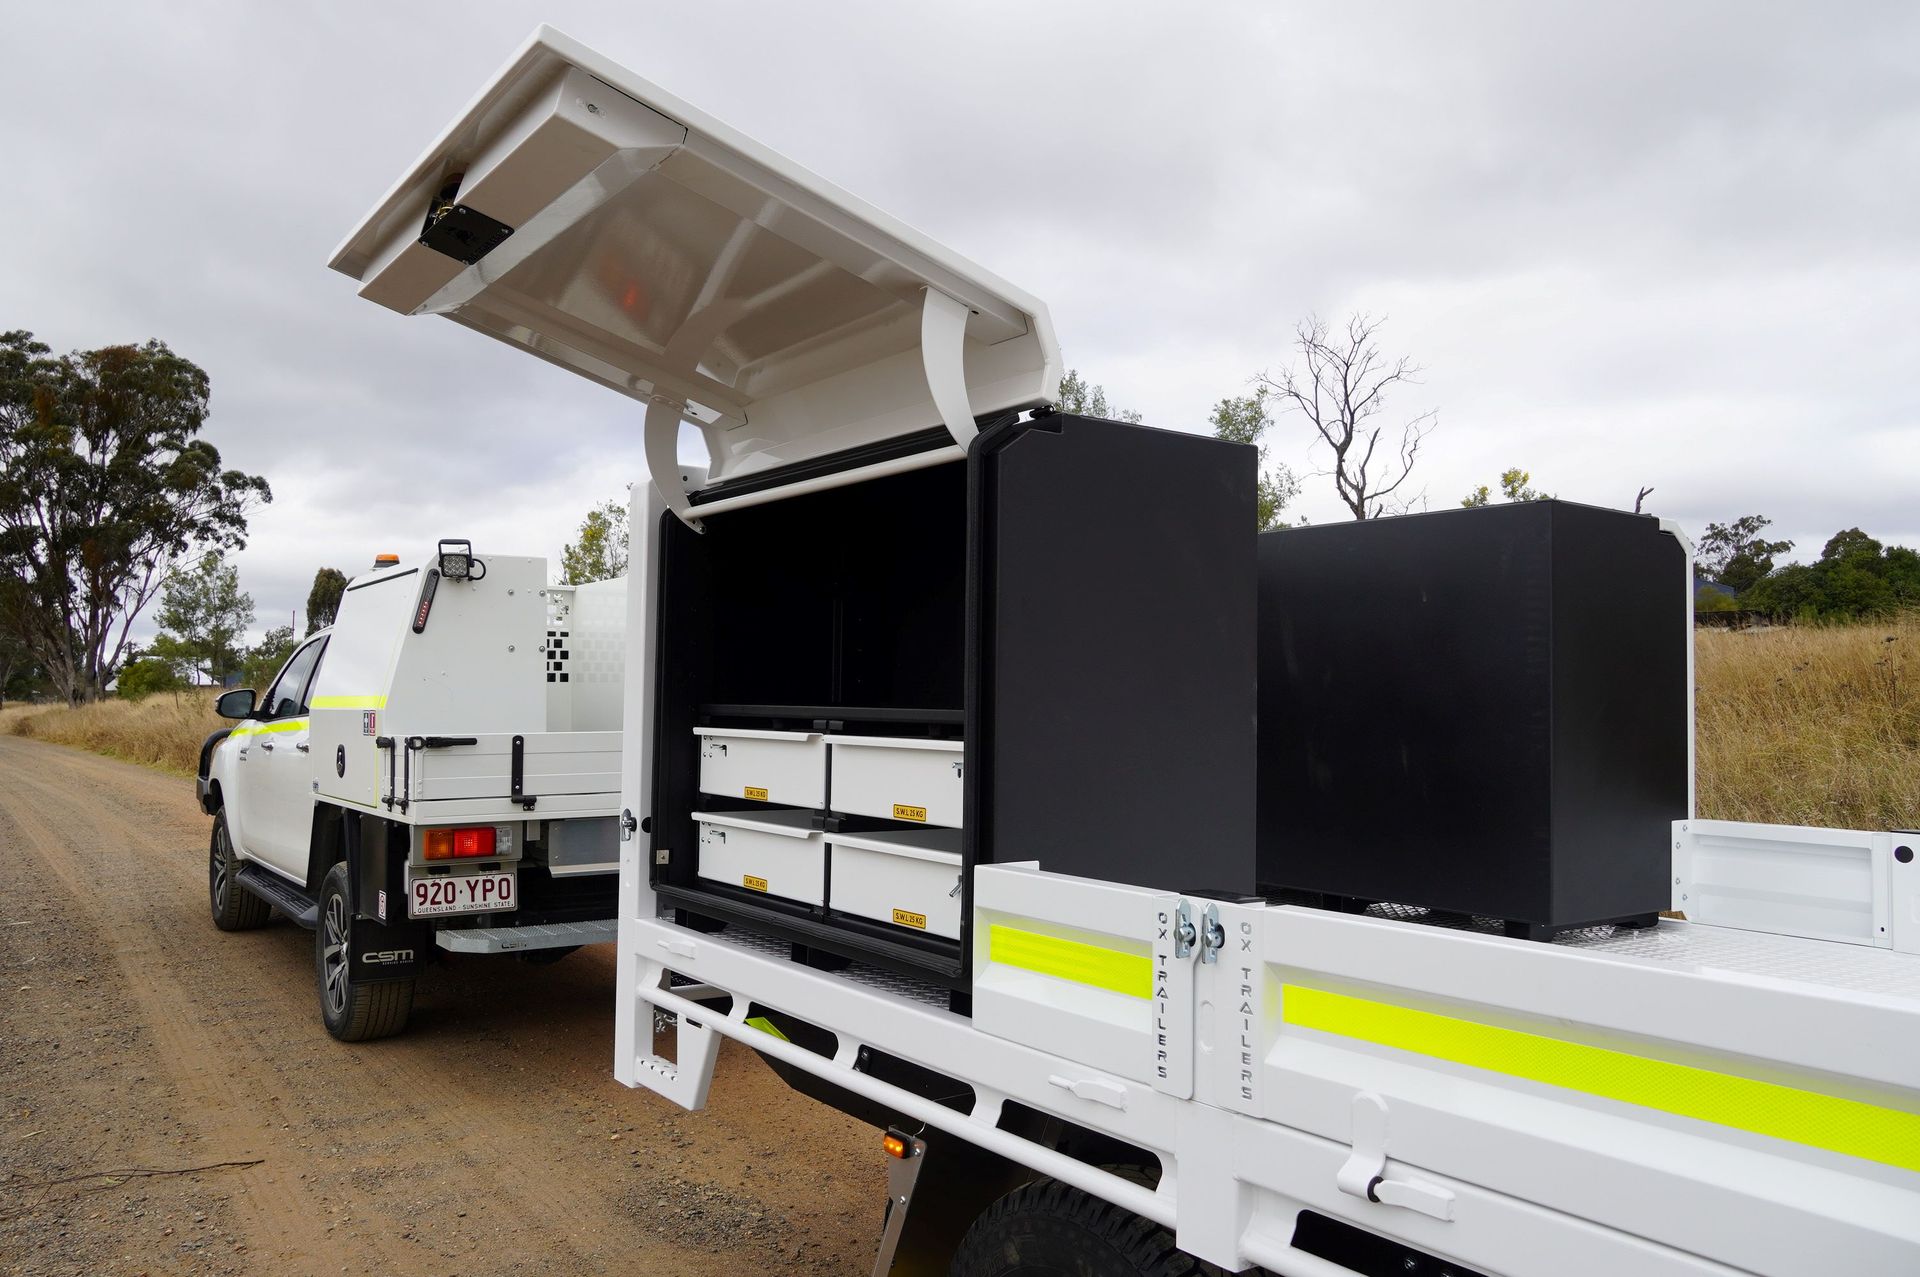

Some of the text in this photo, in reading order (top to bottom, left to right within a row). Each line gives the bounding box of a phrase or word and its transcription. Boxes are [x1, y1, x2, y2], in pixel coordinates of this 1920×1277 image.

[909, 809, 915, 817] 25
[915, 809, 924, 818] KG
[417, 905, 457, 913] QUEENSLAND
[462, 902, 491, 910] SUNSHINE
[909, 915, 915, 923] 25
[915, 916, 923, 925] KG
[1156, 912, 1169, 1079] OX TRAILERS
[1239, 922, 1253, 1100] OX TRAILERS
